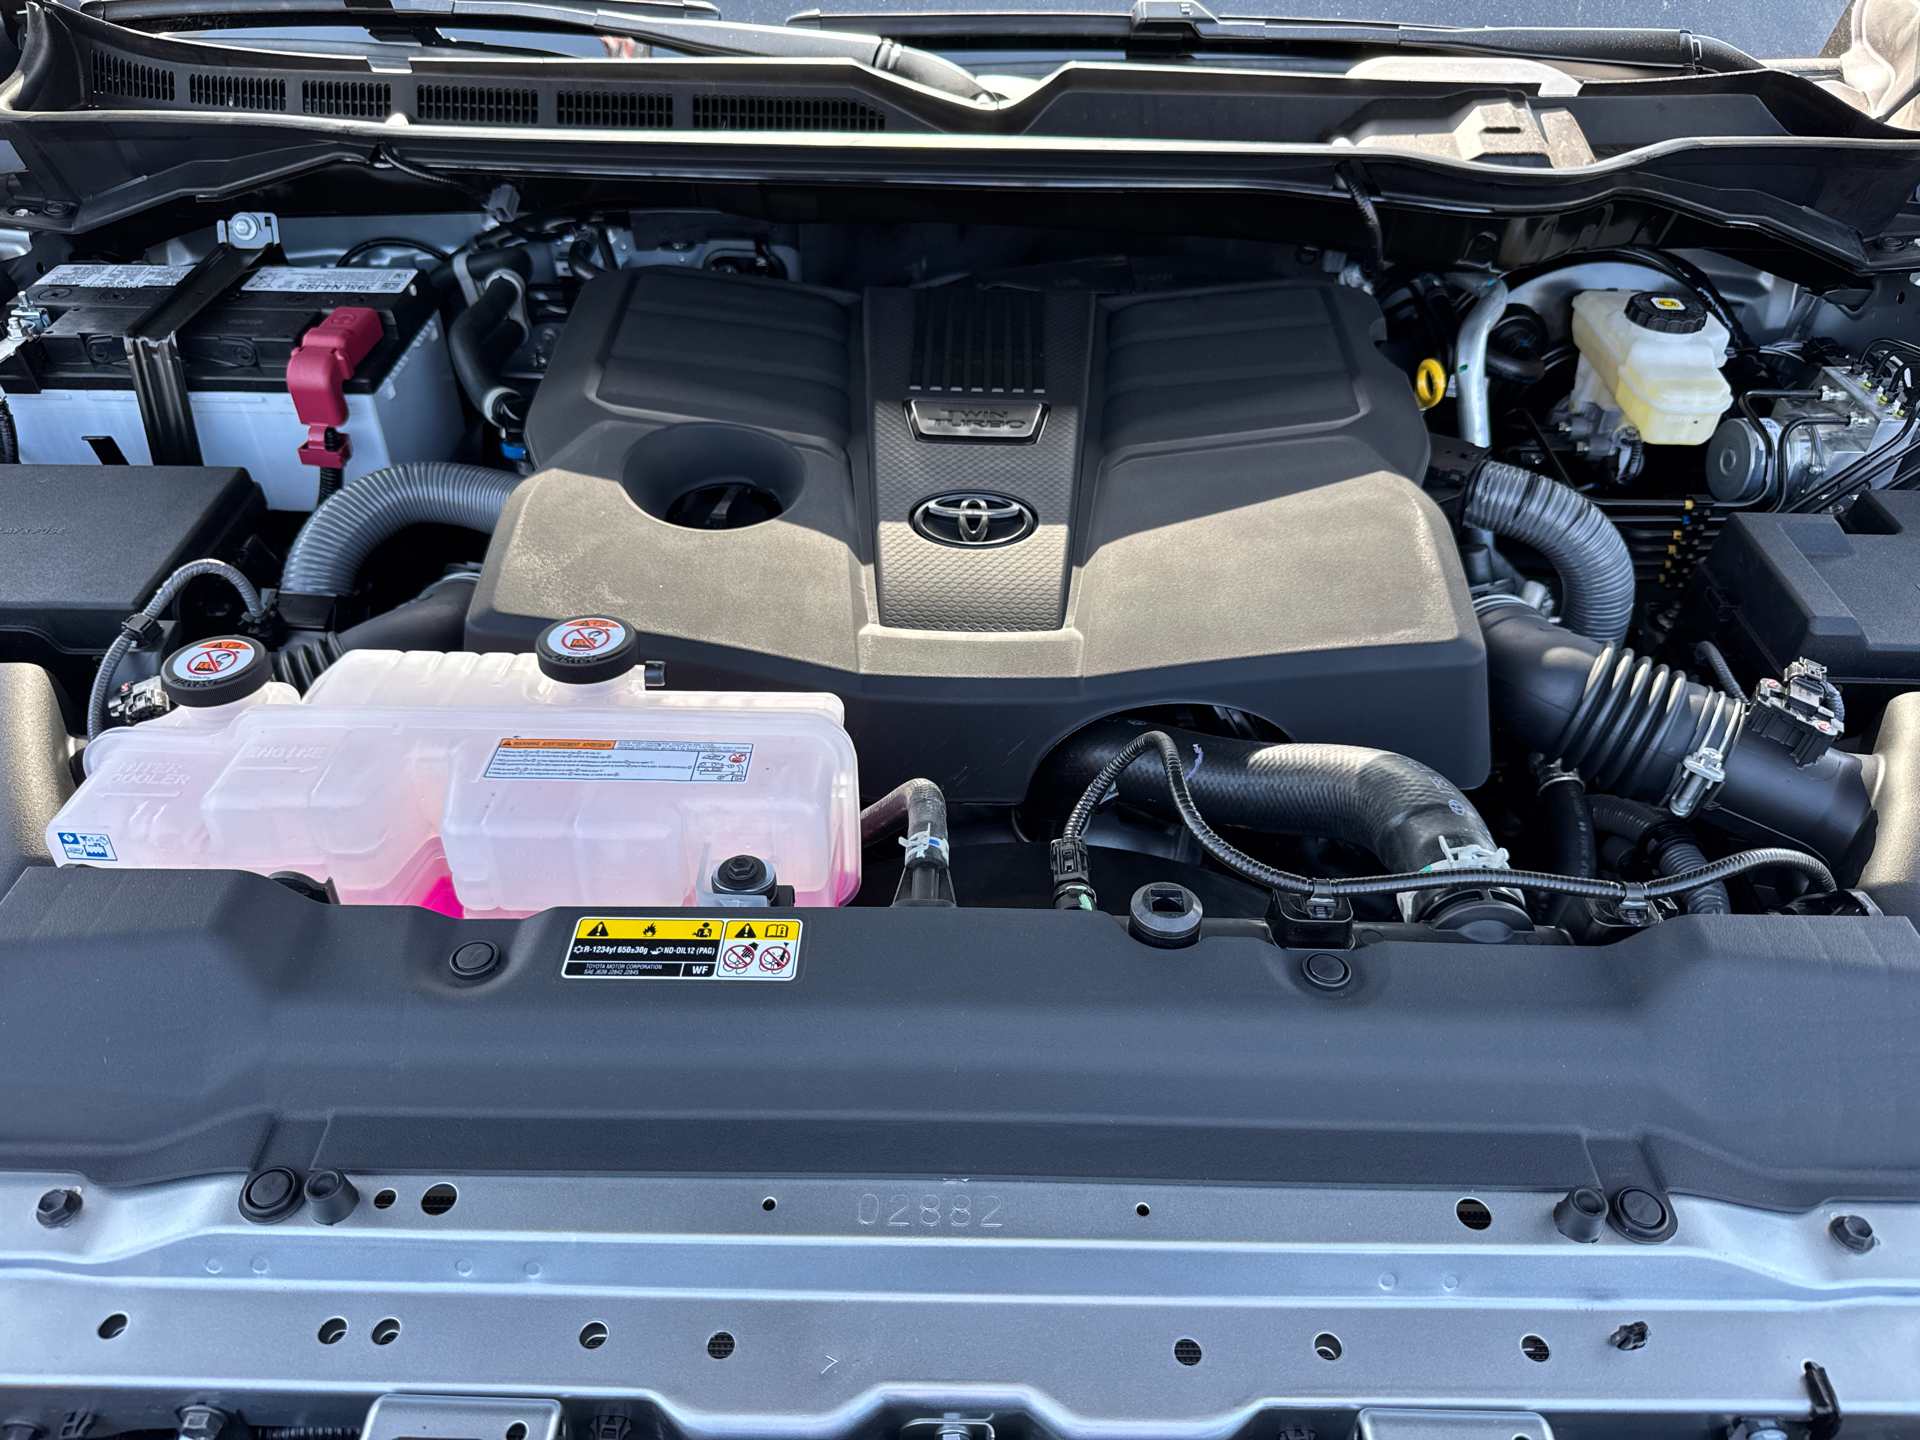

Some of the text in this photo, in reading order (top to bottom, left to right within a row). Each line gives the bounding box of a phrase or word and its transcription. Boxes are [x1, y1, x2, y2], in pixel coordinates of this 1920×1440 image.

[941, 409, 1007, 418] TWIN
[928, 418, 1026, 429] TURBO
[245, 746, 326, 758] ENGINE
[116, 761, 182, 773] INTER
[110, 773, 191, 785] COOLER
[583, 945, 616, 955] R-1234yf
[617, 946, 649, 955] 650±30g
[696, 946, 716, 956] (PAG)
[692, 965, 709, 974] WF
[857, 1193, 1003, 1228] 02882
